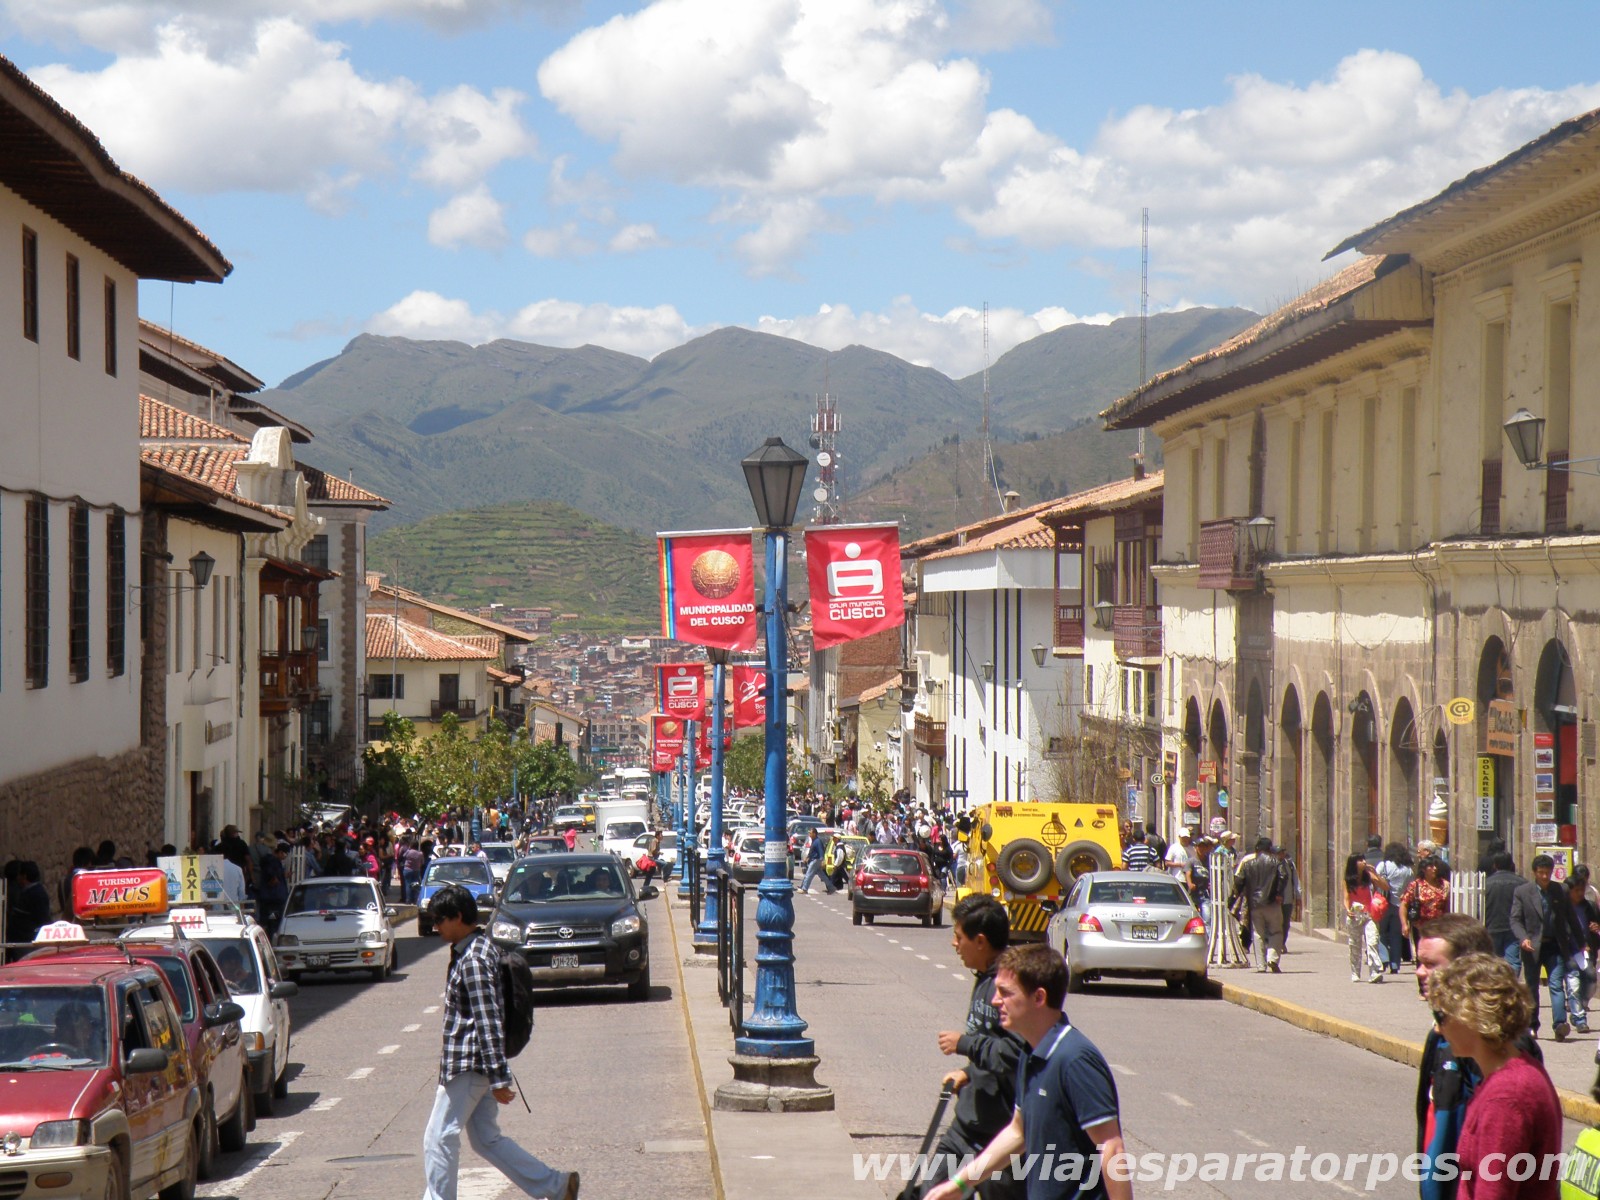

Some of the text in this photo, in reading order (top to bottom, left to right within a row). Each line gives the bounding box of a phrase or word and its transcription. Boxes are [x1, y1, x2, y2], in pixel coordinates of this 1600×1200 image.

[680, 603, 754, 615] MUNICIPALIDAD
[849, 600, 884, 608] MUNICIPAL
[829, 606, 886, 620] CUSCO
[690, 615, 745, 626] DEL CUSCO
[668, 701, 699, 709] CUSCO
[97, 877, 141, 887] TURISMO
[186, 856, 198, 901] TAXI
[87, 886, 150, 905] MAUS
[172, 916, 202, 929] TAXI
[44, 927, 78, 939] TAXI
